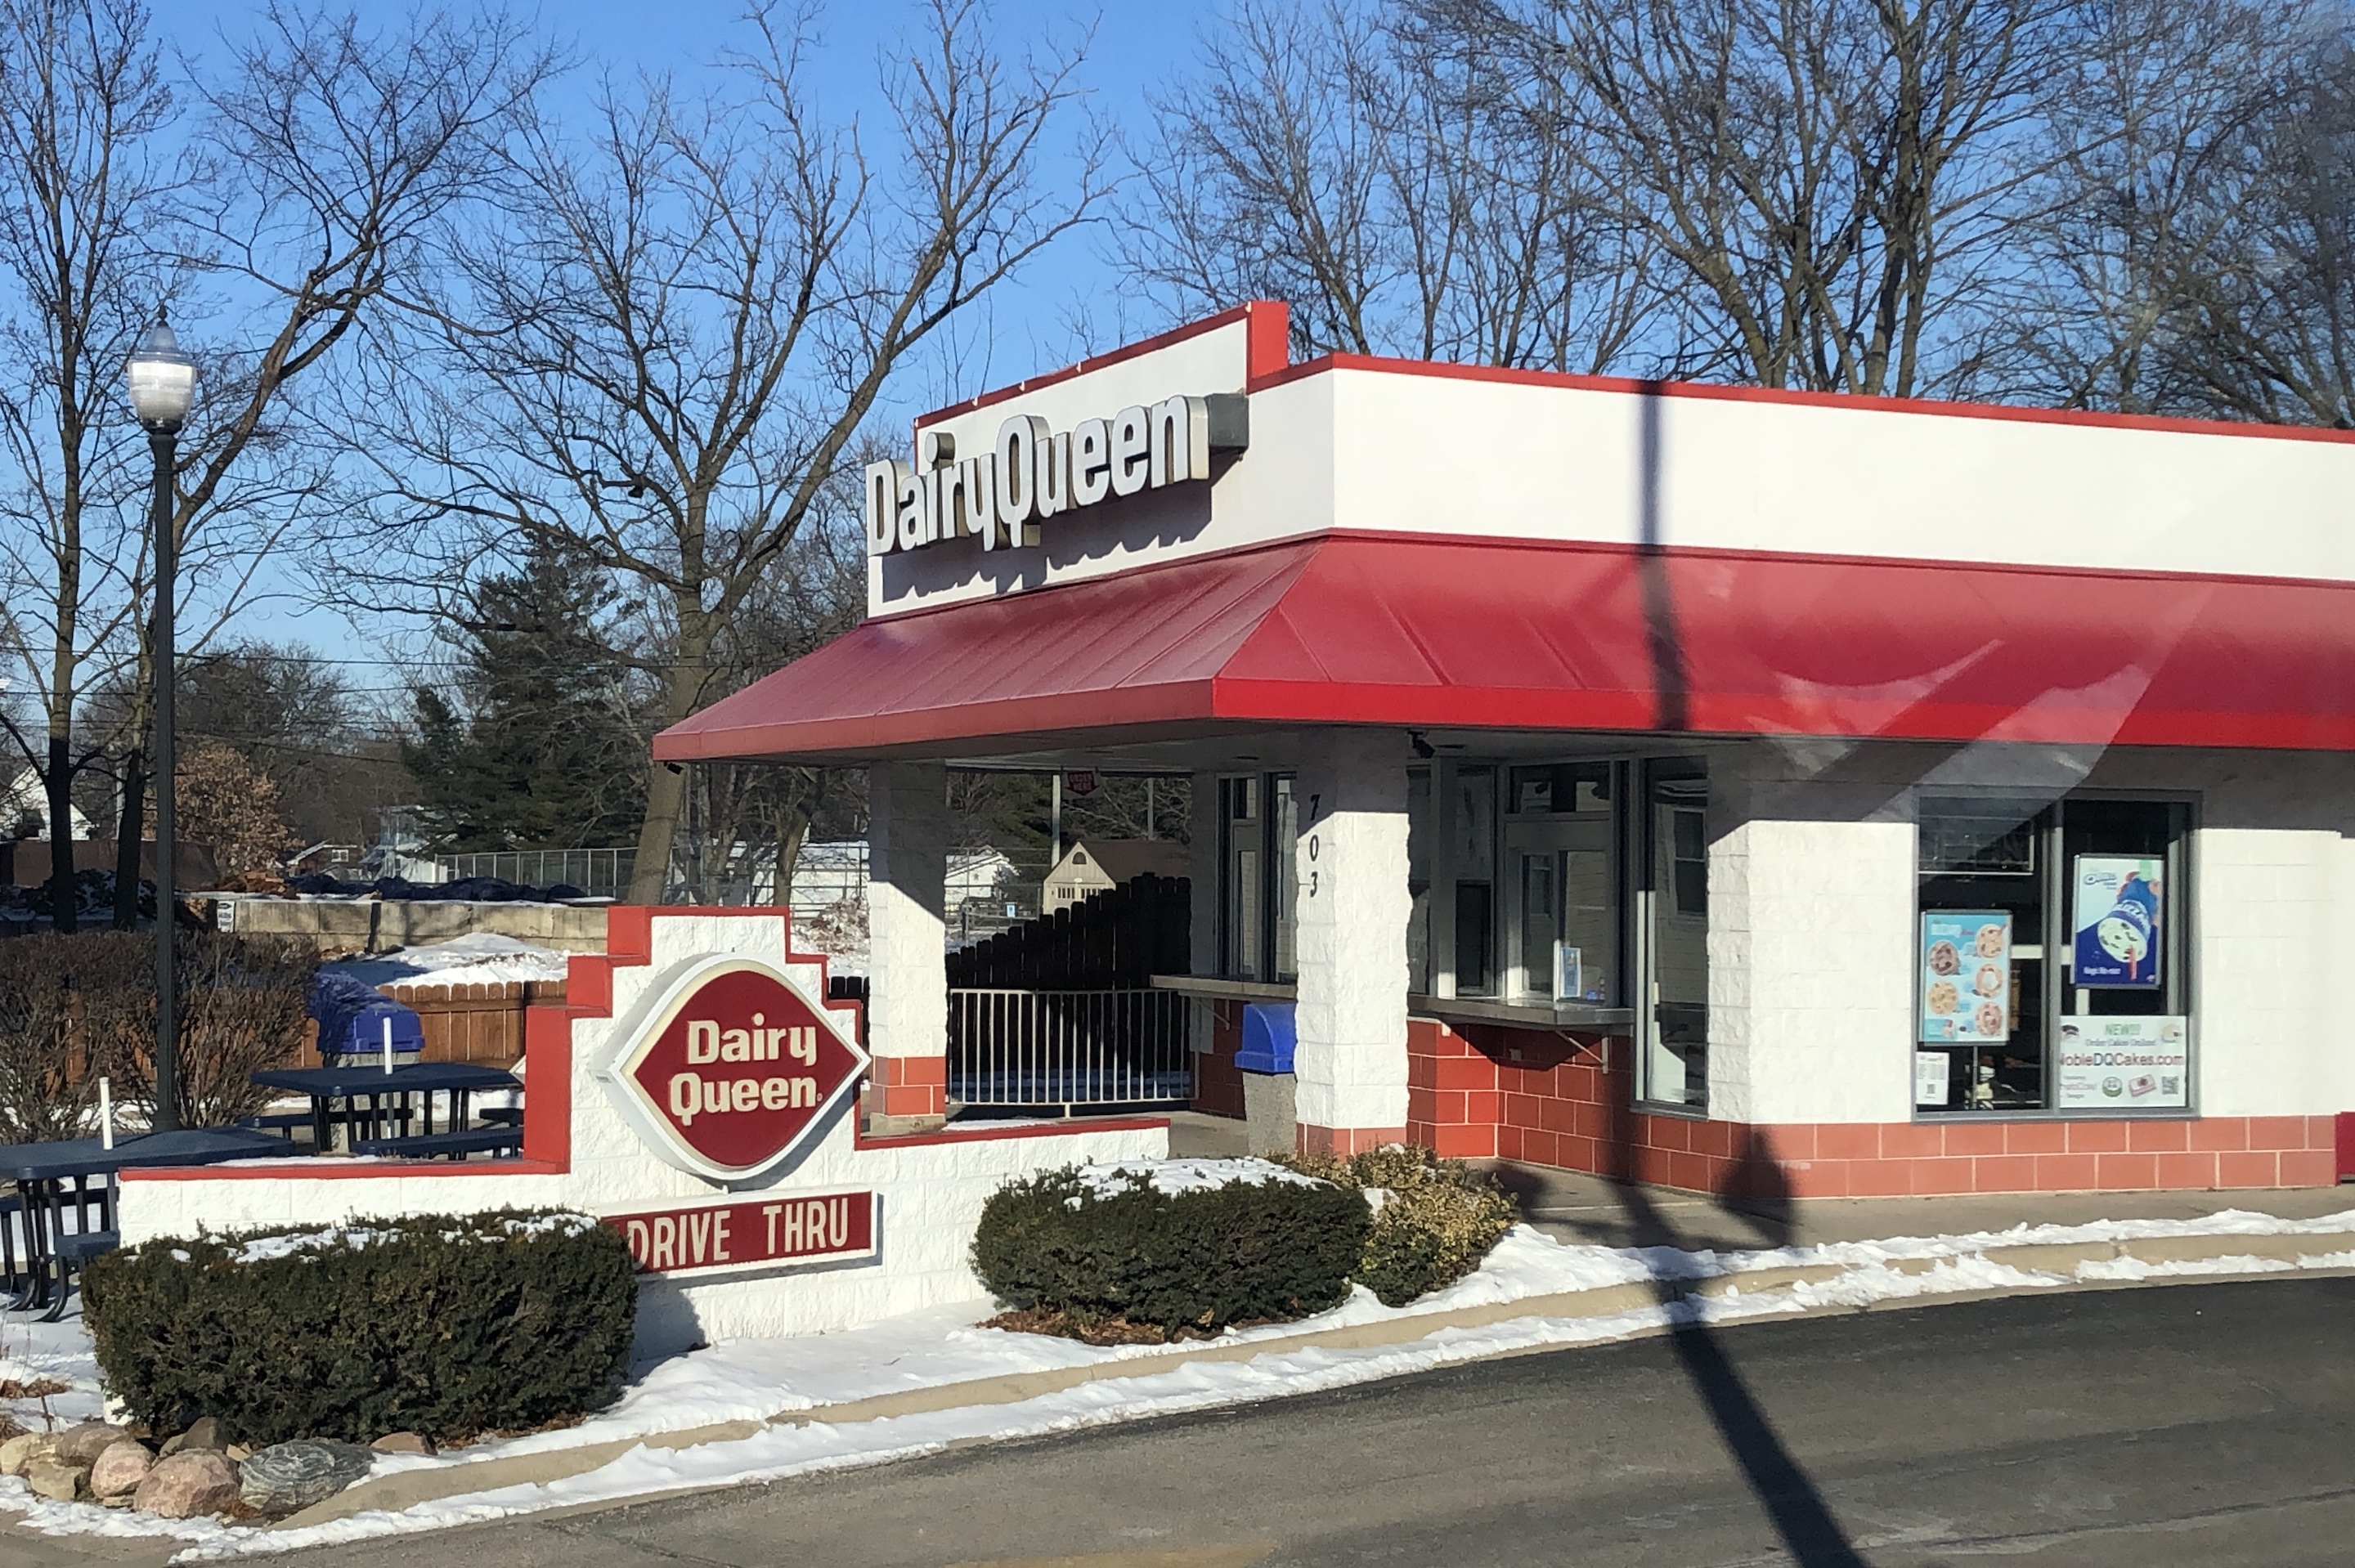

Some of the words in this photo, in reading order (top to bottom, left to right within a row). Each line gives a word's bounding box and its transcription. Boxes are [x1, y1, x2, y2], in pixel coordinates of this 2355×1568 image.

[1069, 773, 1093, 782] ORDER
[1073, 782, 1092, 791] HERE
[687, 1013, 817, 1066] Dairy
[668, 1073, 817, 1127] Queen
[627, 1210, 731, 1270] DRIVE
[762, 1197, 849, 1255] THRU
